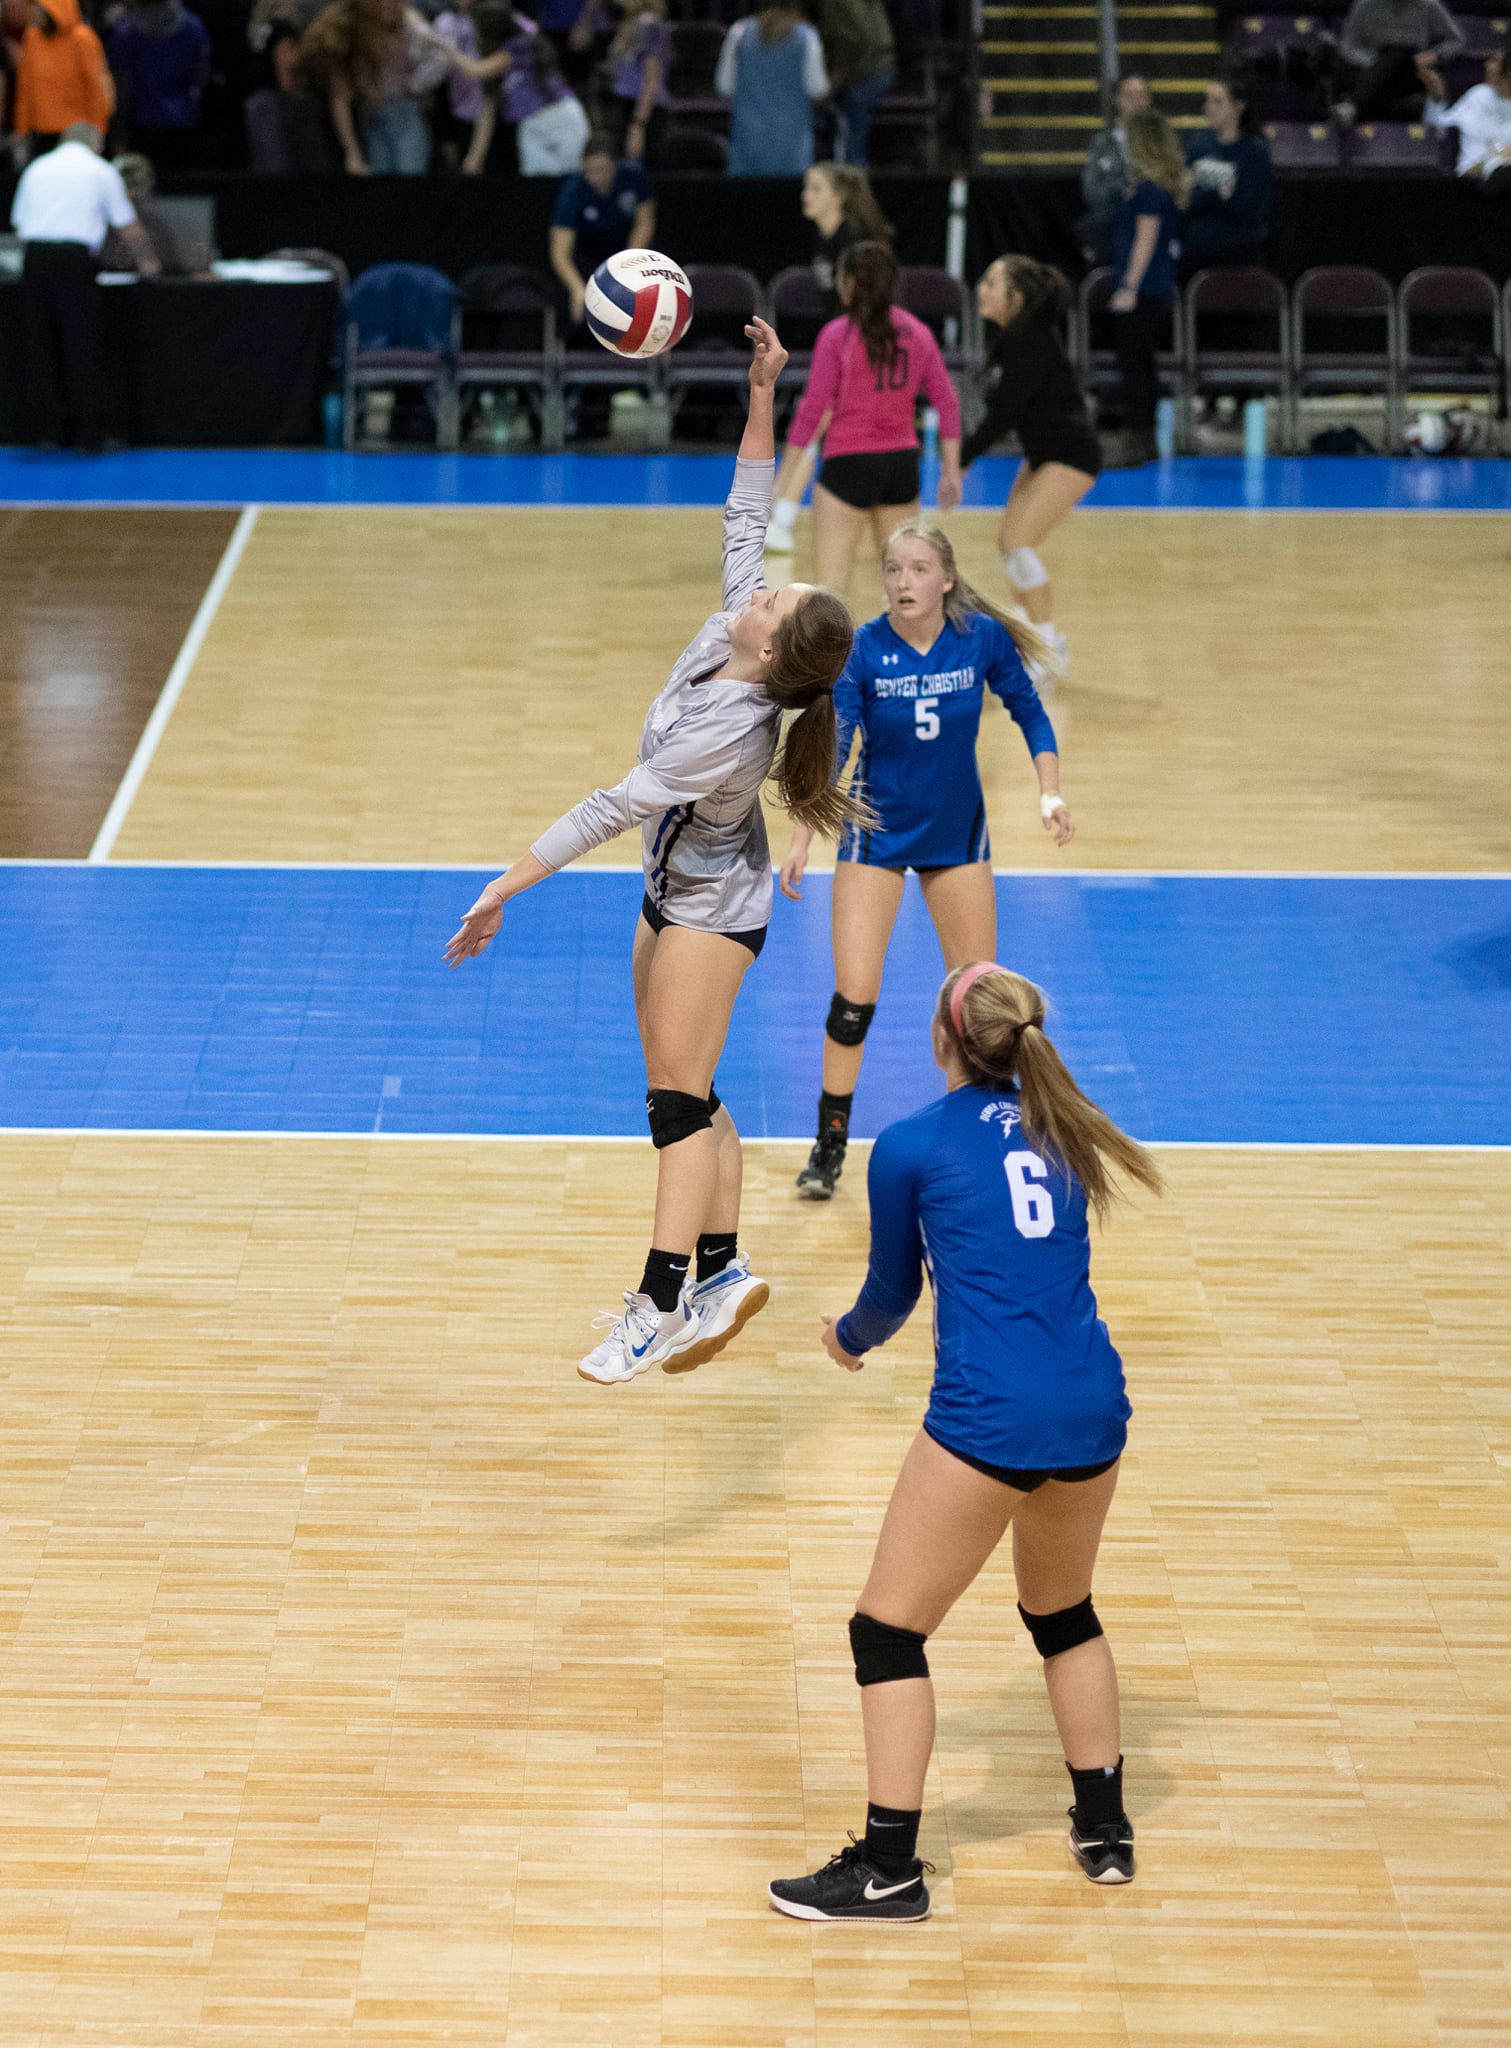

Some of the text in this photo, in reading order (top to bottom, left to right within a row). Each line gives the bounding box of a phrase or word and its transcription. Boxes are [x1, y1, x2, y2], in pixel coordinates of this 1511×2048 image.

[641, 268, 685, 285] Wilson
[915, 697, 940, 740] 5
[1003, 1150, 1055, 1239] 6
